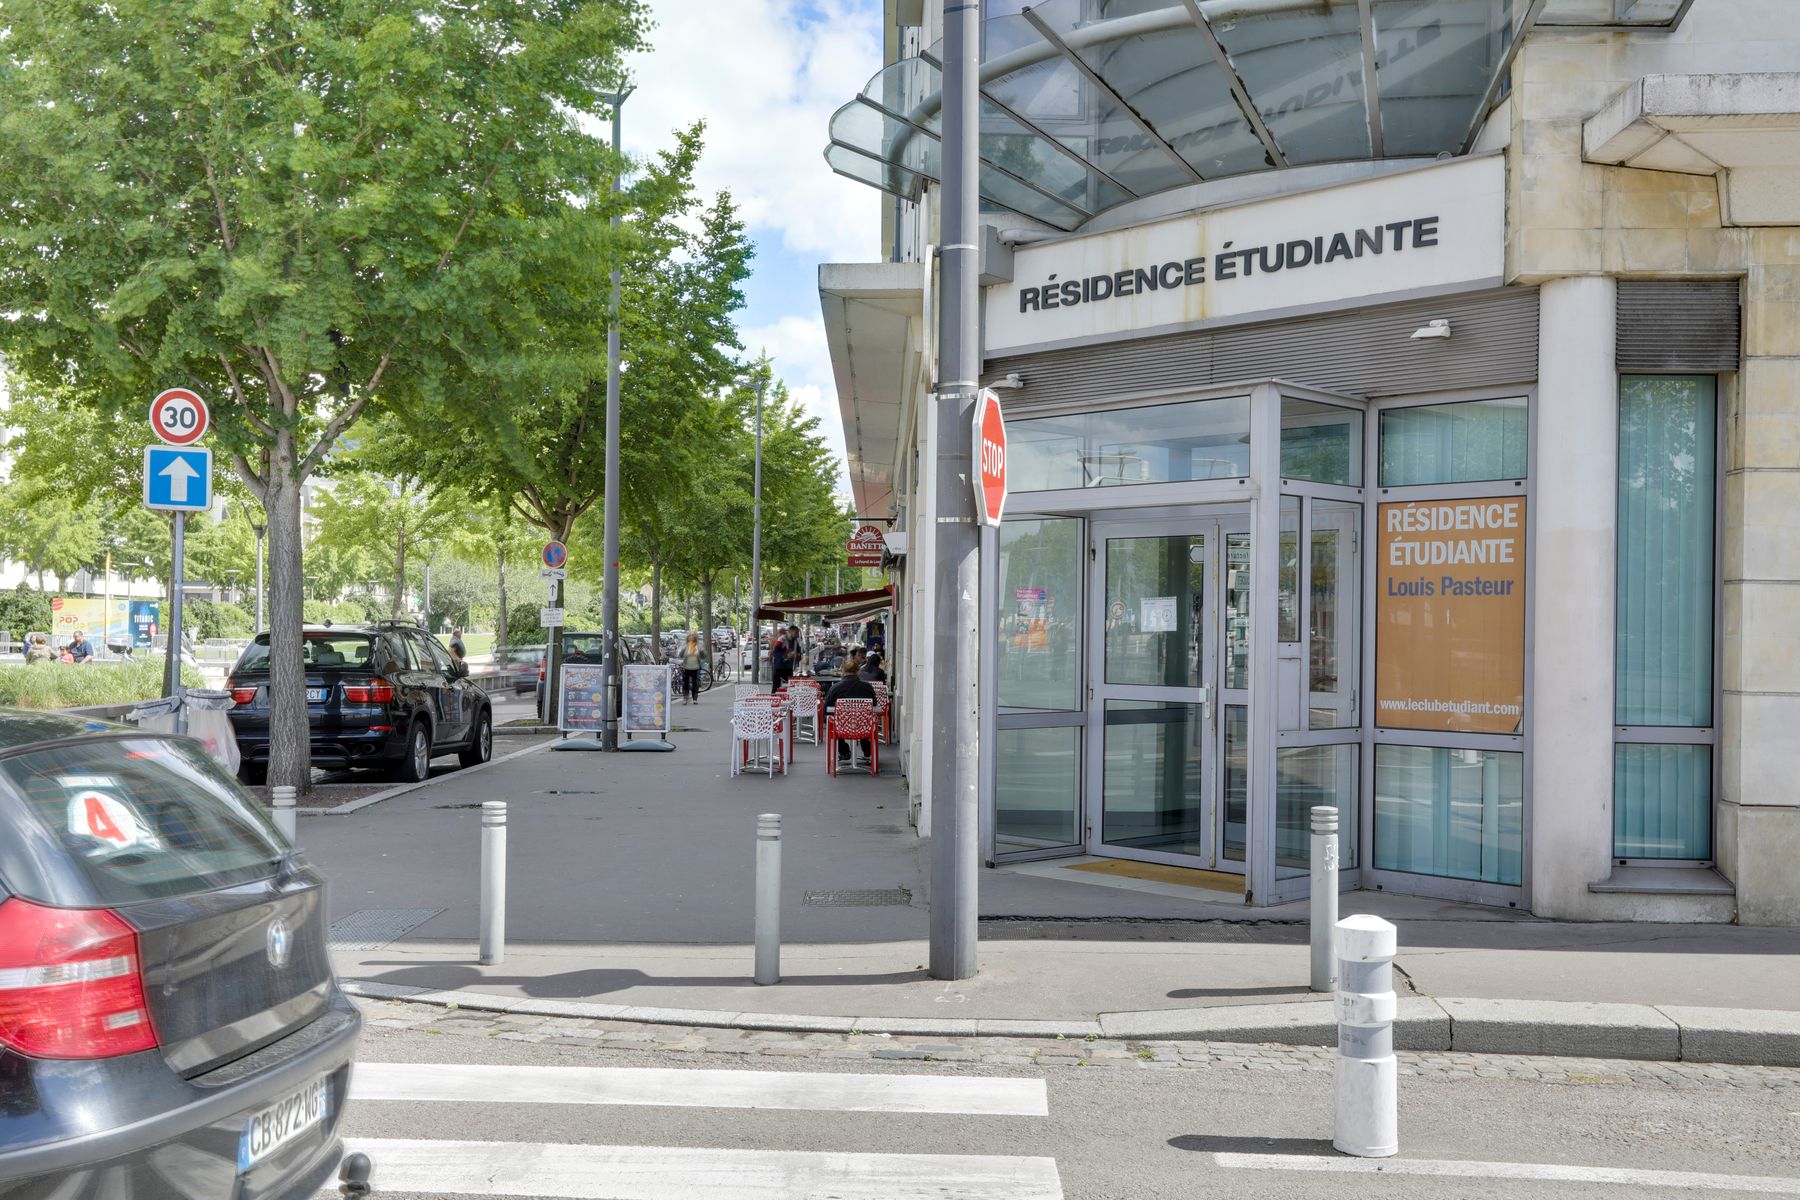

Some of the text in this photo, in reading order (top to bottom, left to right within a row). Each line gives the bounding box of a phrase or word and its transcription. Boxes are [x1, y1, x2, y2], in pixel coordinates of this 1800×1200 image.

[1019, 215, 1440, 314] RÉSIDENCE ÉTUDIANTE
[163, 406, 196, 429] 30
[982, 437, 1004, 479] STOP
[1387, 502, 1519, 533] RÉSIDENCE
[1389, 535, 1515, 566] ÉTUDIANTE
[1387, 575, 1515, 597] Louis Pasteur
[1379, 698, 1520, 716] www.leclubetudiant.com
[83, 796, 129, 842] A
